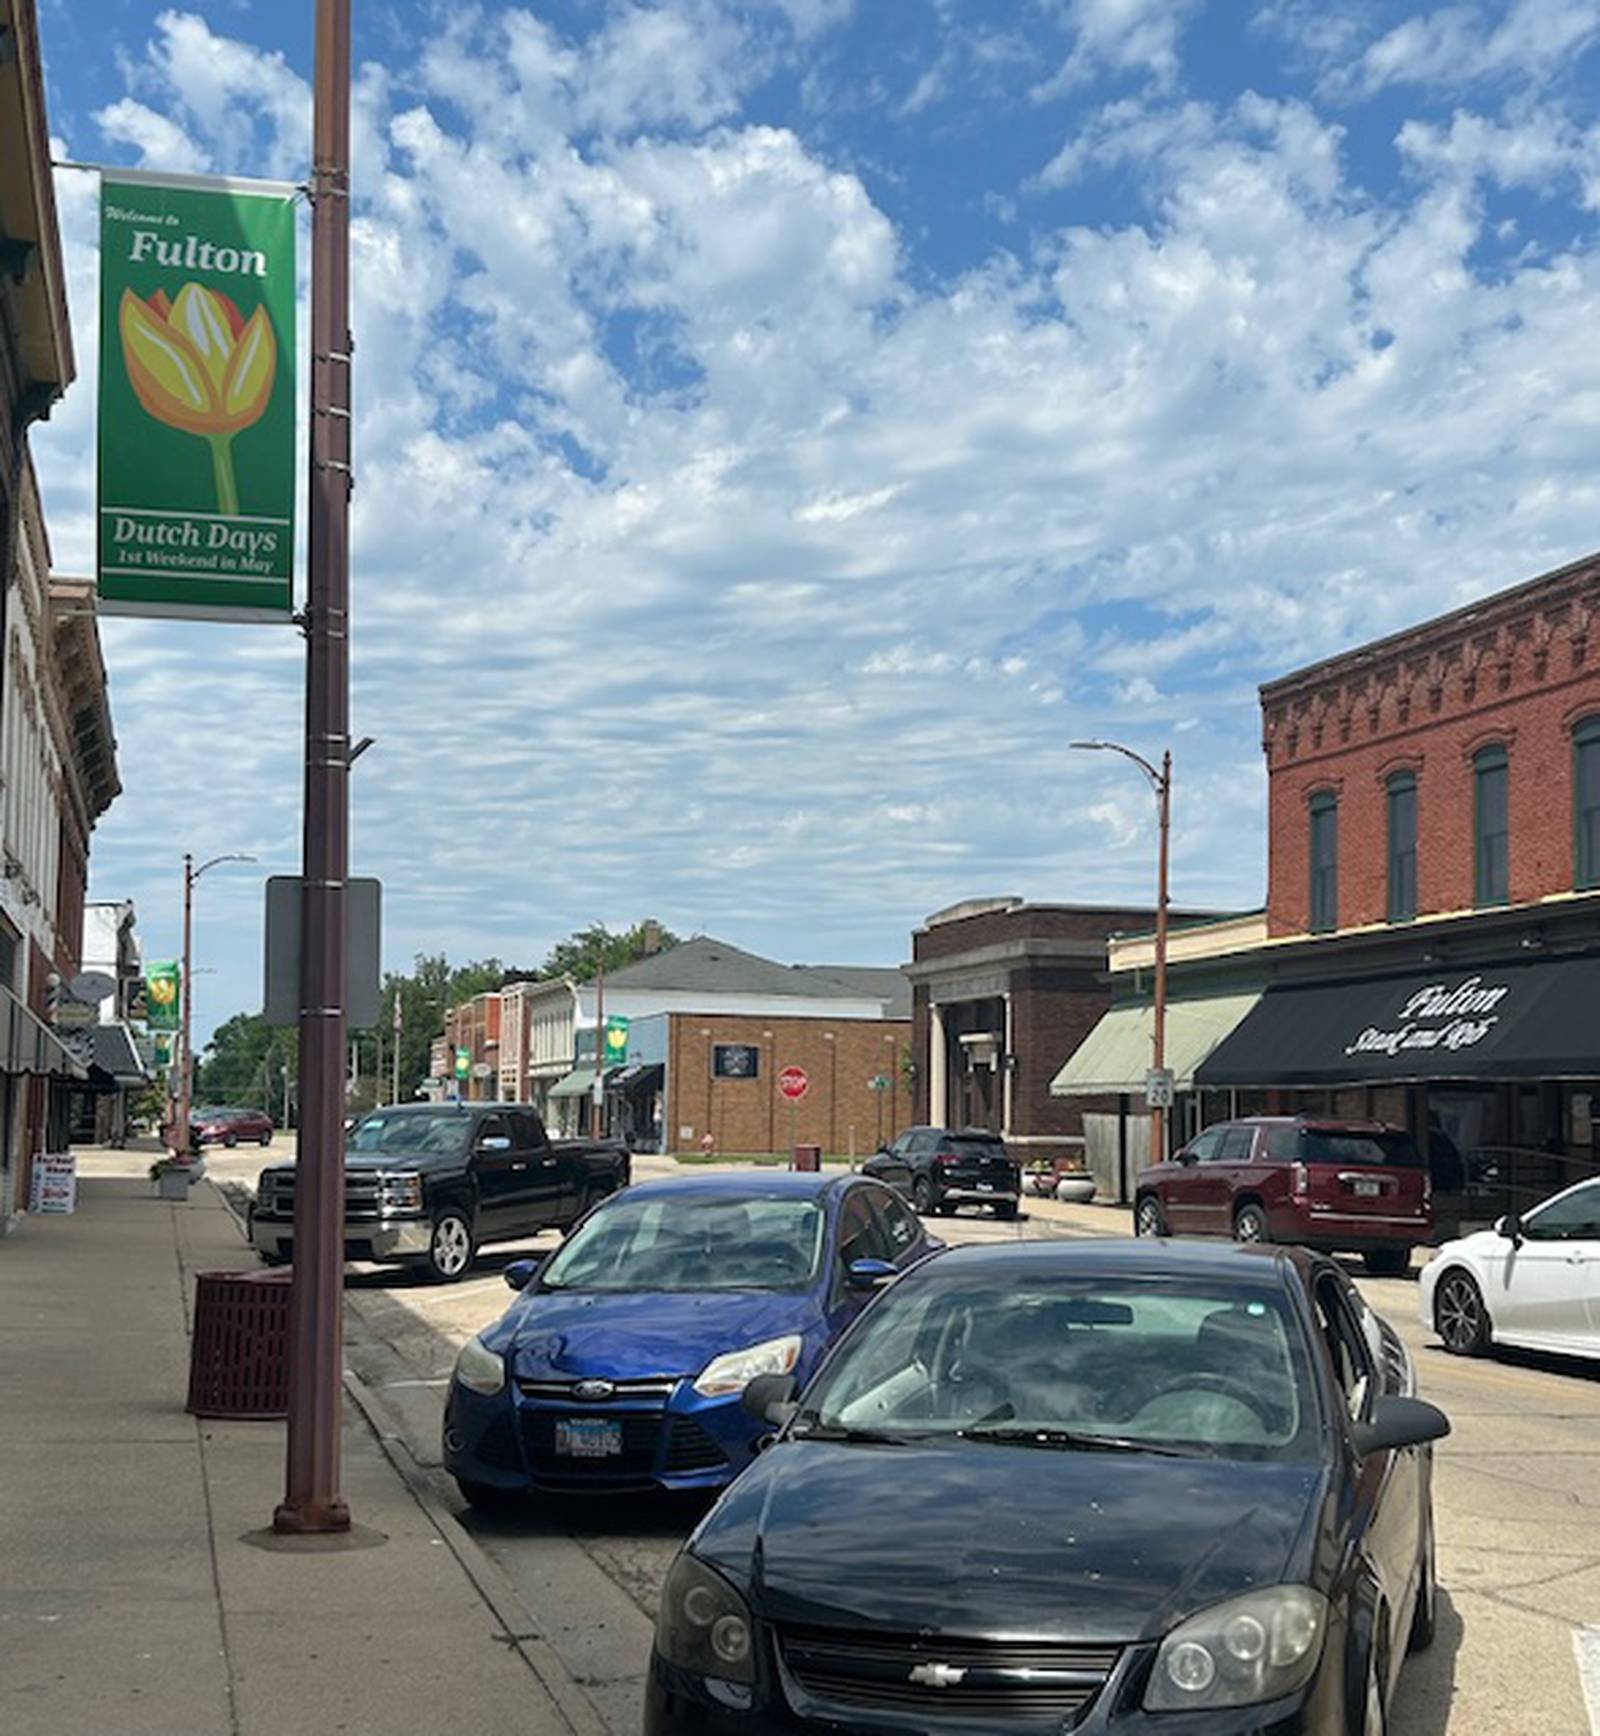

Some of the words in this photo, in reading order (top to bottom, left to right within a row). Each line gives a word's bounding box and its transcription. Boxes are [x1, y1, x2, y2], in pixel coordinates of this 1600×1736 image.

[105, 206, 163, 224] Welcome
[165, 214, 180, 226] to
[128, 230, 267, 277] Fulton
[114, 517, 200, 547] Dutch
[208, 523, 278, 556] Days
[118, 549, 142, 564] 1st
[146, 550, 217, 568] Weekend
[220, 557, 237, 571] in
[239, 557, 274, 574] May
[1398, 975, 1508, 1019] Fulton
[1345, 1022, 1417, 1055] Steak
[1401, 1018, 1460, 1048] and
[779, 1076, 808, 1090] STOP
[1151, 1089, 1169, 1103] 20
